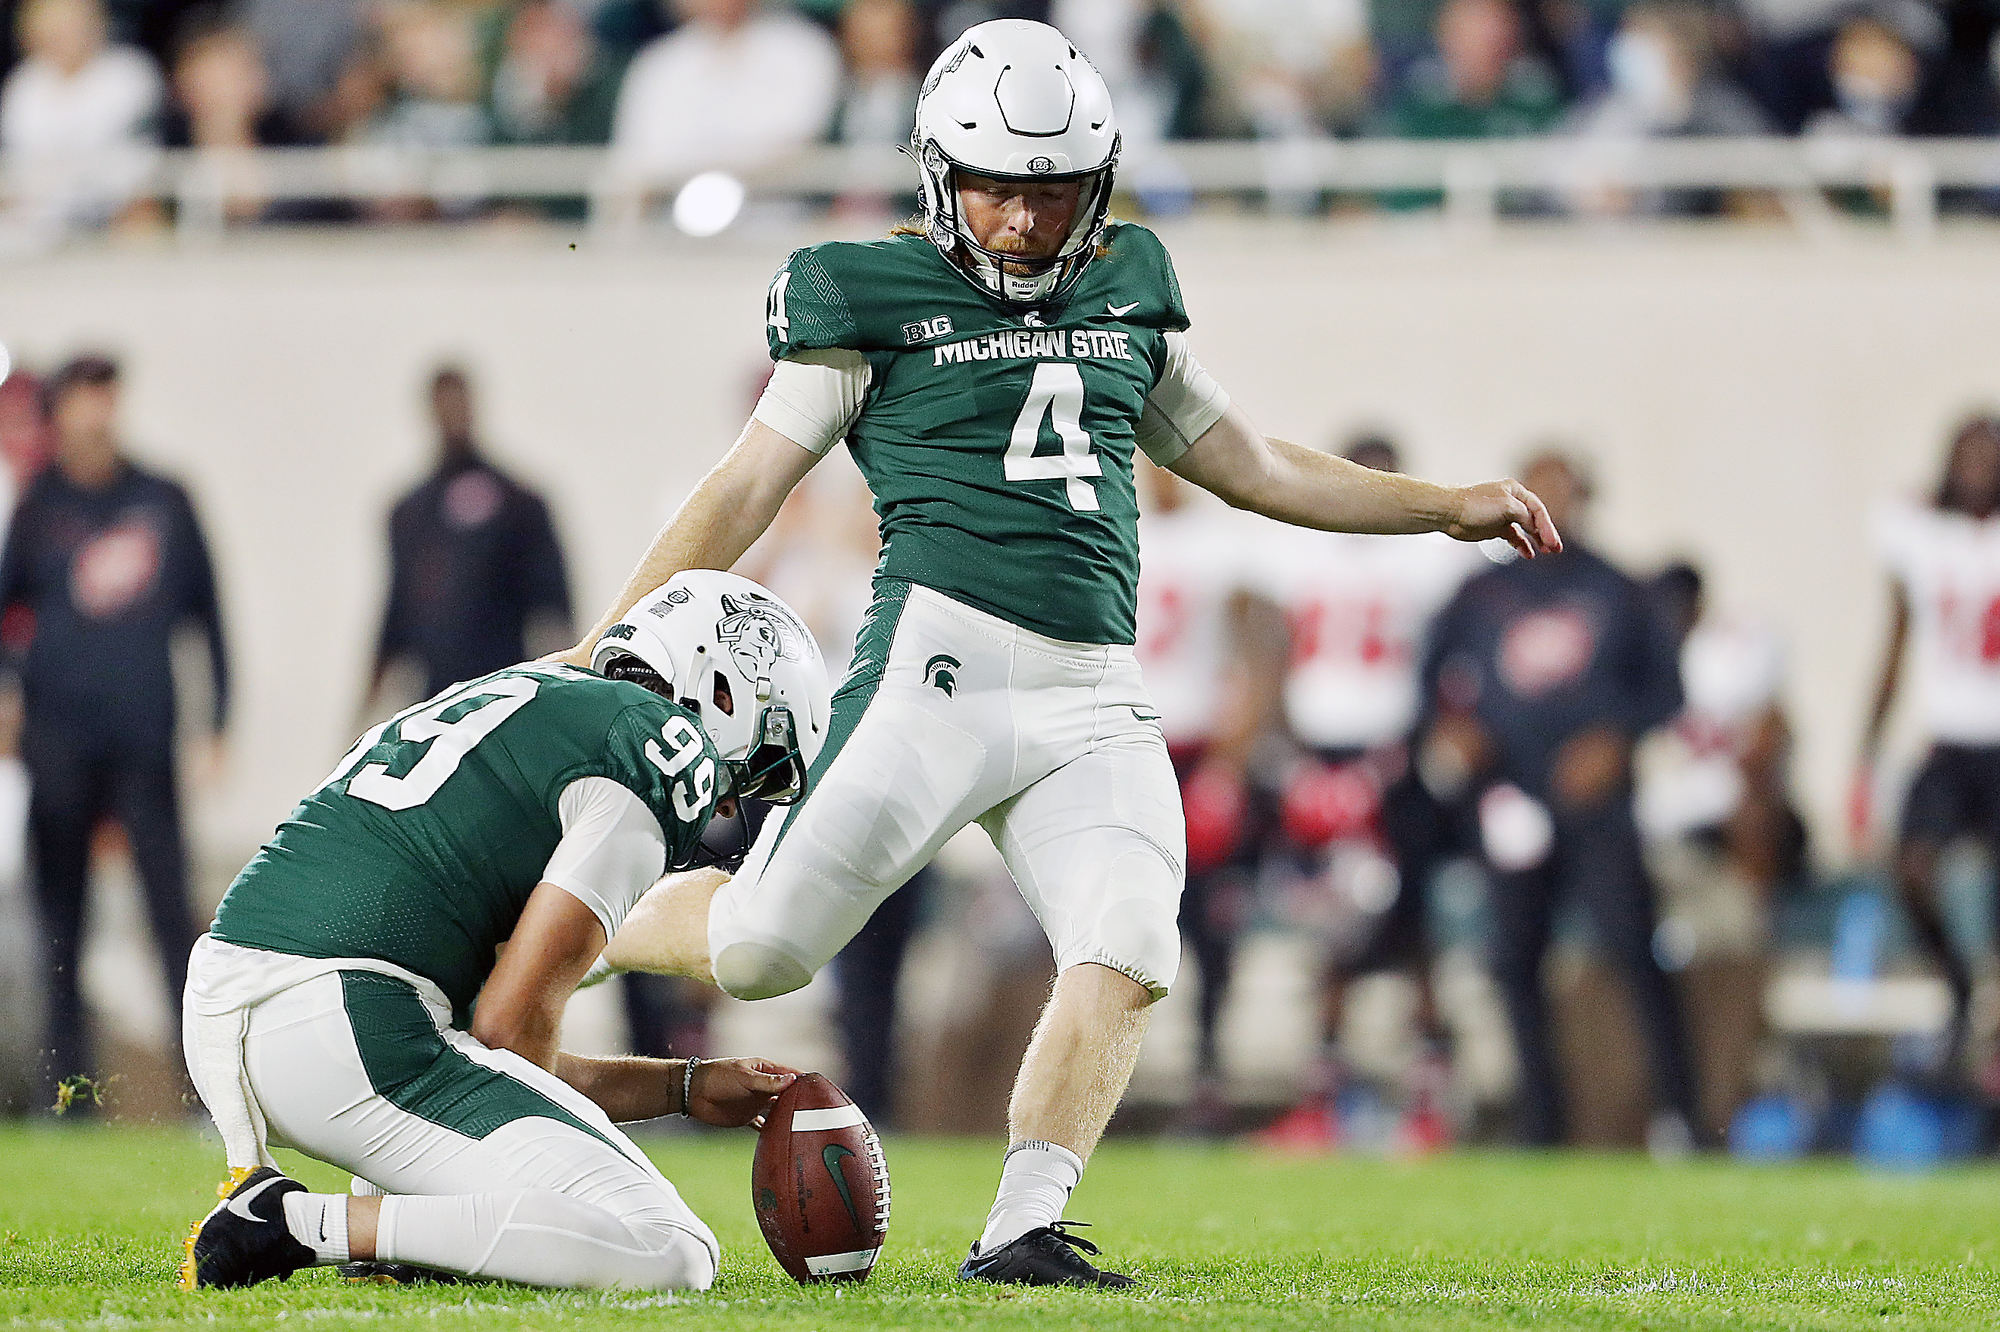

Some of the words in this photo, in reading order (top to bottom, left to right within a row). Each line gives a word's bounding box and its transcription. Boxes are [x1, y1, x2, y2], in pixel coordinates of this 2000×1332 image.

[768, 270, 791, 343] 4
[932, 330, 1066, 366] MICHIGAN
[1071, 329, 1133, 361] STATE
[1003, 362, 1102, 513] 4
[644, 714, 715, 823] 99
